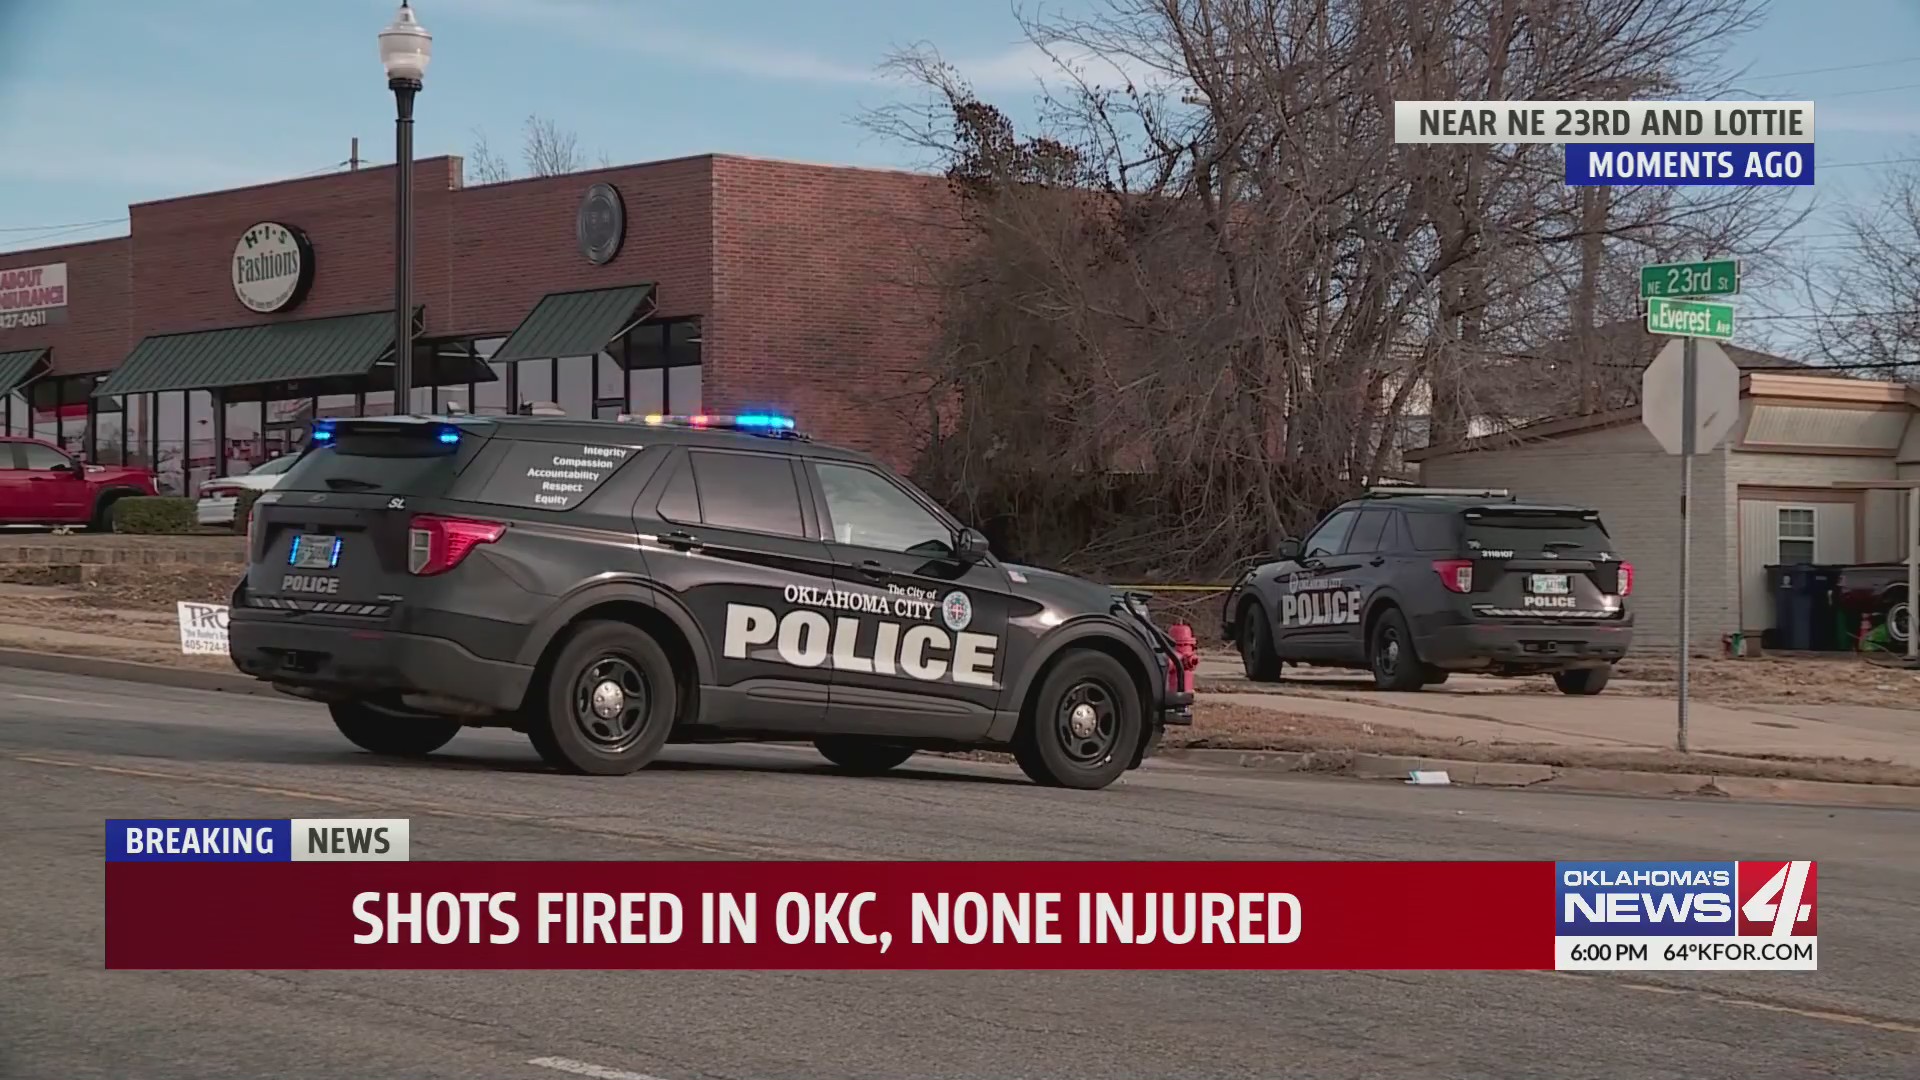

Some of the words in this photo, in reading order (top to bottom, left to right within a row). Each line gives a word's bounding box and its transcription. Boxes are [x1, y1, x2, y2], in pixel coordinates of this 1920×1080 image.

[237, 250, 298, 284] Fashions
[0, 269, 42, 290] ABOUT
[1647, 281, 1661, 294] NE
[1667, 267, 1712, 293] 23rd
[1717, 277, 1728, 290] St
[1652, 313, 1658, 327] N
[1660, 303, 1712, 332] Everest
[1716, 320, 1731, 334] Ave
[584, 445, 627, 458] Integrity
[553, 457, 613, 468] Compassion
[527, 468, 599, 481] Accountability
[542, 481, 583, 492] Respect
[535, 494, 568, 505] Equity
[282, 575, 340, 593] POLICE
[887, 584, 905, 596] The
[906, 586, 925, 600] City
[926, 588, 937, 599] of
[784, 584, 890, 615] OKLAHOMA
[894, 599, 935, 620] CITY
[1282, 591, 1360, 625] POLICE
[1524, 596, 1576, 607] POLICE
[723, 603, 998, 686] POLICE
